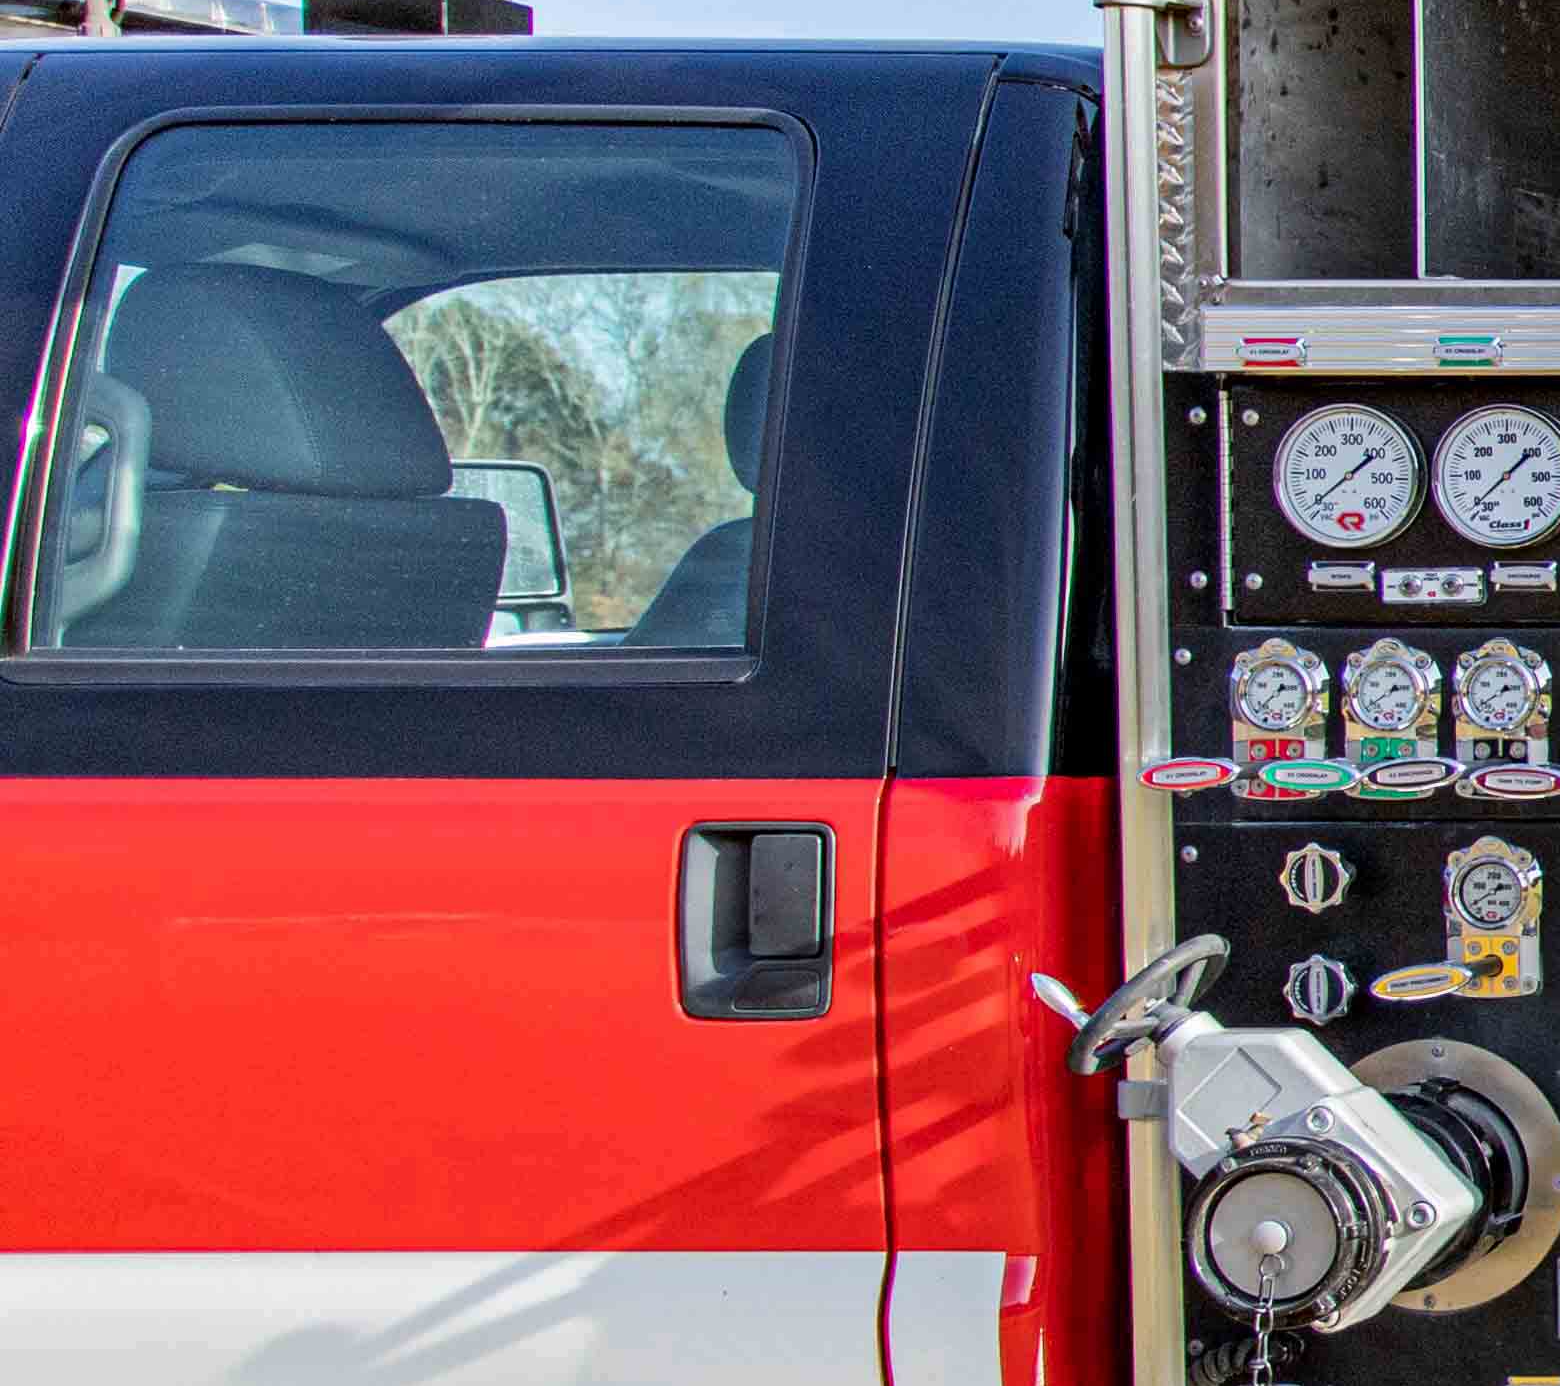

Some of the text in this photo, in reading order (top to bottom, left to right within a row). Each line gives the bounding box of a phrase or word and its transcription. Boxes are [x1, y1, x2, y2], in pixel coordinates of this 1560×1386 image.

[1341, 433, 1363, 445] 300
[1498, 433, 1517, 444] 300
[1315, 445, 1337, 457] 200
[1474, 447, 1493, 457] 200
[1305, 468, 1326, 480] 100
[1371, 472, 1393, 485] 500
[1464, 470, 1481, 480] 100
[1531, 472, 1550, 482] 500
[1364, 497, 1386, 509] 600
[1524, 497, 1543, 507] 600
